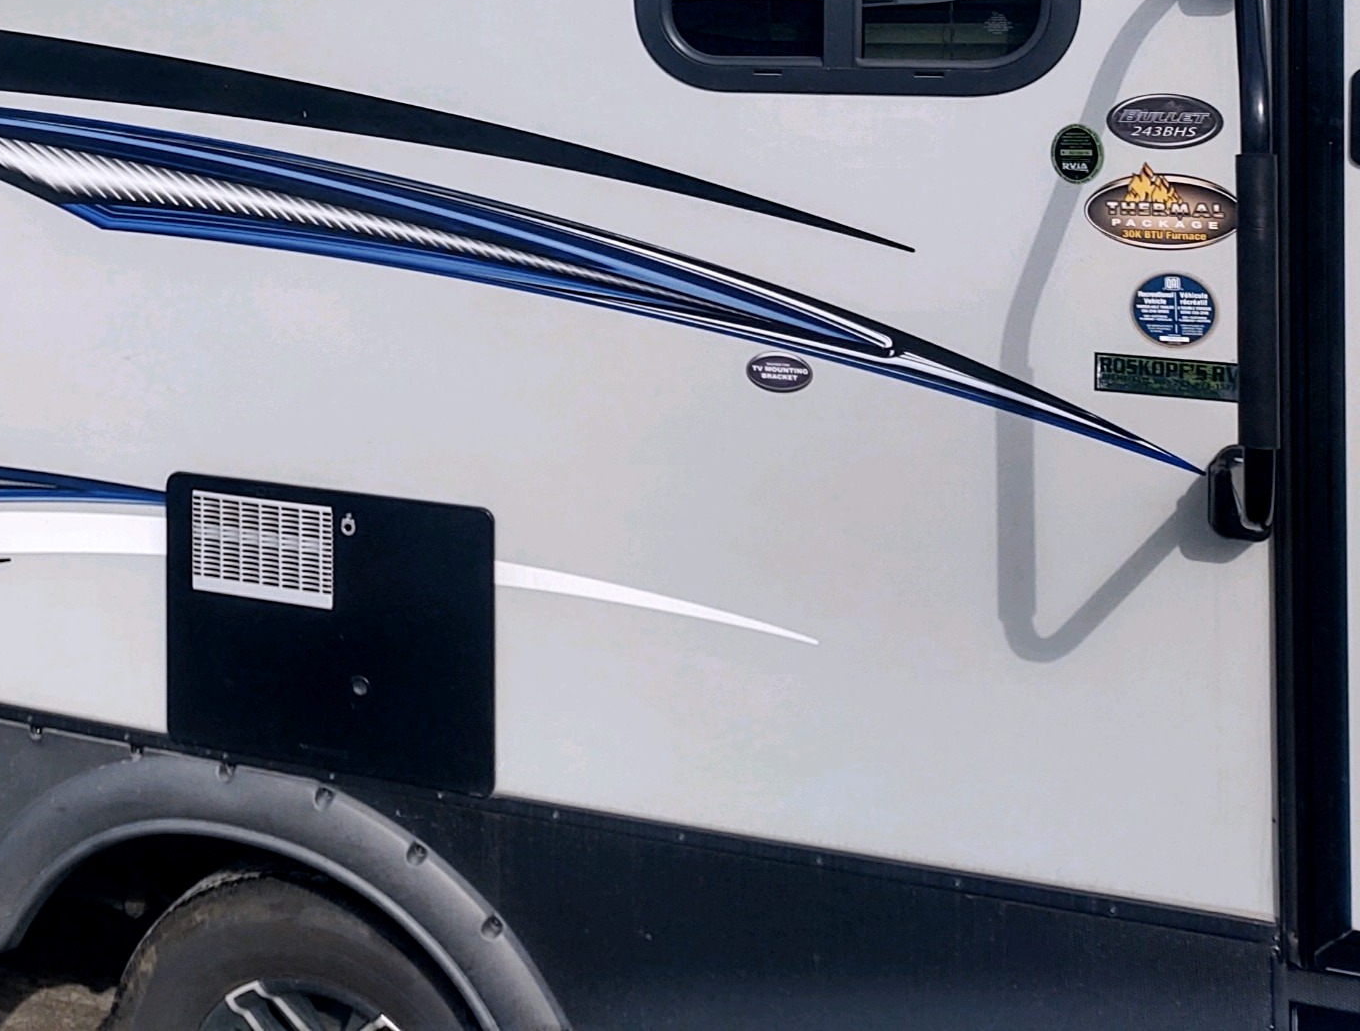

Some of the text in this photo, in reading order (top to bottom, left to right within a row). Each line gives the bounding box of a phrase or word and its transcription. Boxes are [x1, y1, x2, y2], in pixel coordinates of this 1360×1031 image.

[1130, 126, 1198, 137] 243BHS
[1062, 162, 1089, 171] RVIA
[1105, 200, 1225, 219] THERMAL
[1111, 218, 1219, 230] PACKAGE
[1122, 229, 1207, 241] 30K BTU Furnace
[765, 366, 809, 375] MOUNTING
[761, 373, 798, 381] BRACKET
